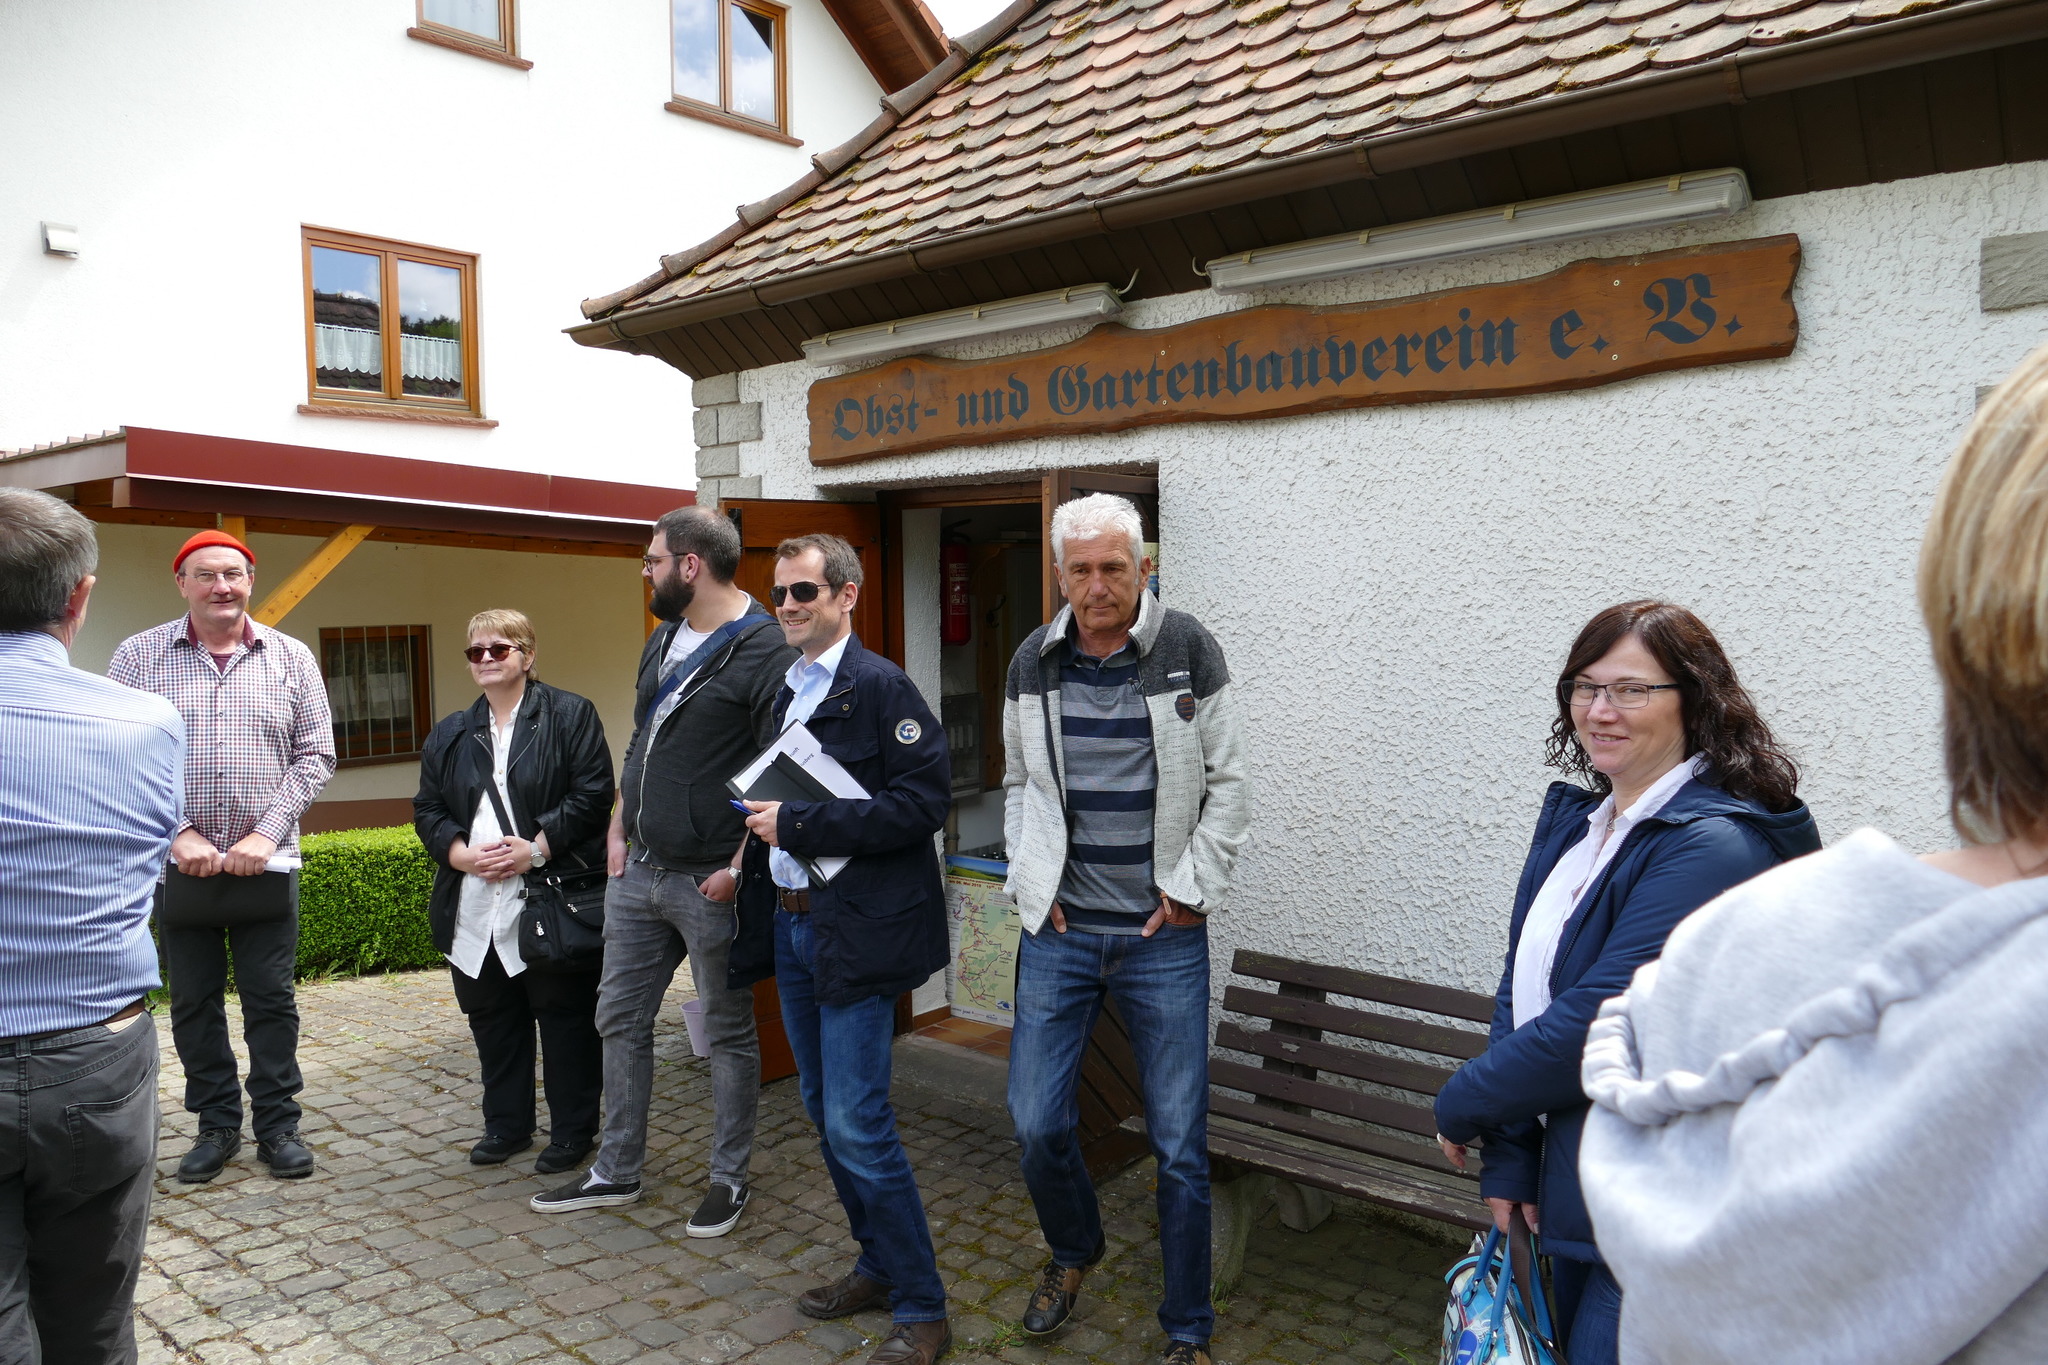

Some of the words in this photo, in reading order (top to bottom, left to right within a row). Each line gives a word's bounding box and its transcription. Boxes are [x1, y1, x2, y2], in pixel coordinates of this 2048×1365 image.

[832, 393, 938, 441] Obst-
[955, 372, 1030, 428] und
[1047, 307, 1522, 416] Gartenbauverein
[1549, 308, 1610, 360] e.
[1643, 273, 1744, 345] V.
